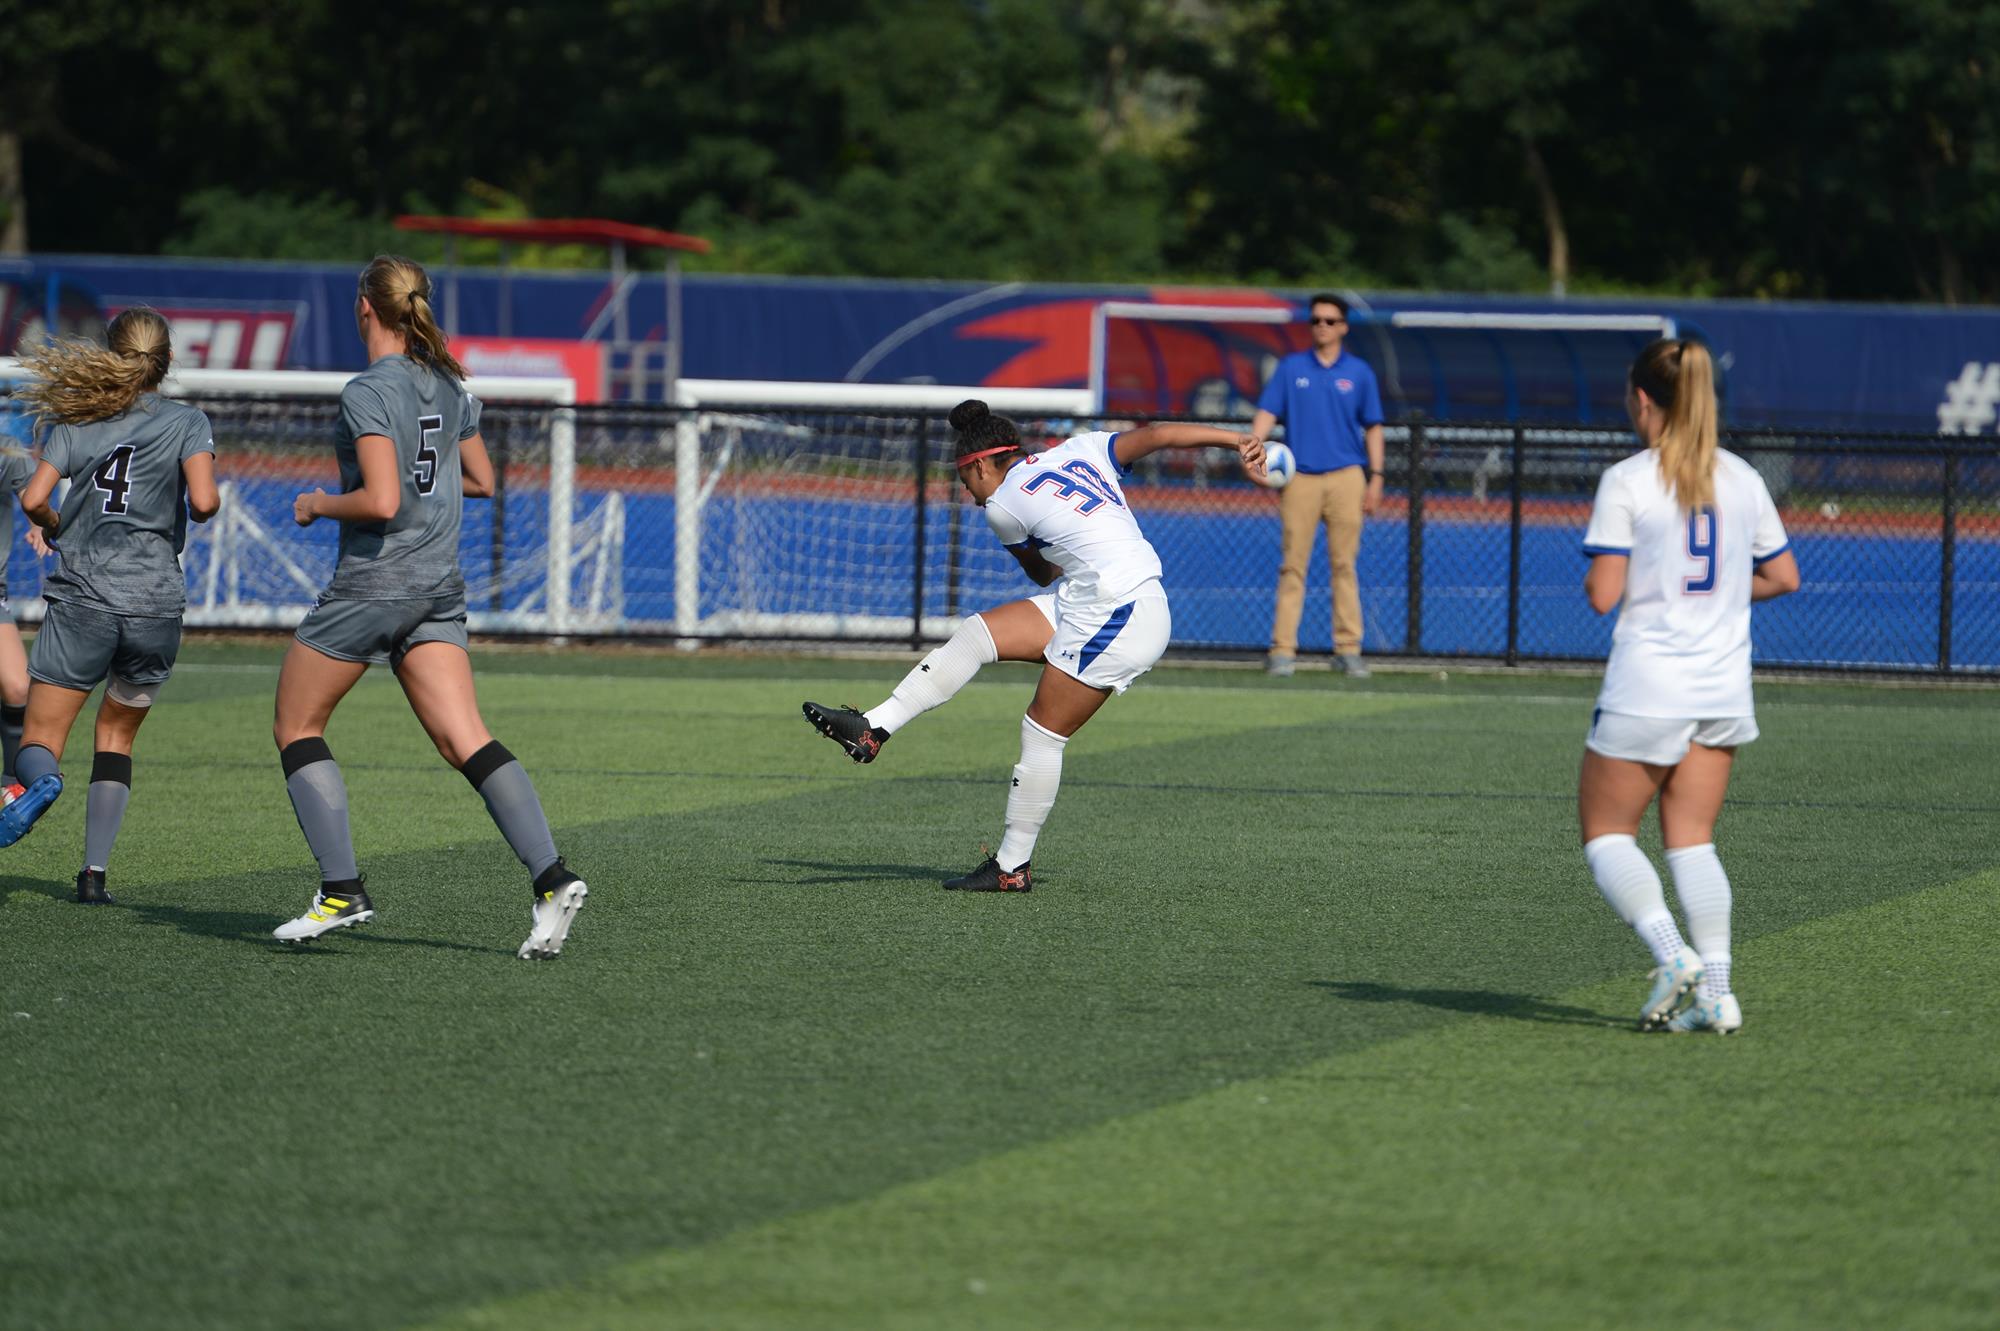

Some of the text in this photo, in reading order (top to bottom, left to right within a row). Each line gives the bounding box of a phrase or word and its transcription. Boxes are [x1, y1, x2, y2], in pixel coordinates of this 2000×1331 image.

[92, 444, 136, 515] 4
[413, 414, 442, 496] 5
[1020, 458, 1126, 517] 30
[1680, 503, 1724, 596] 9
